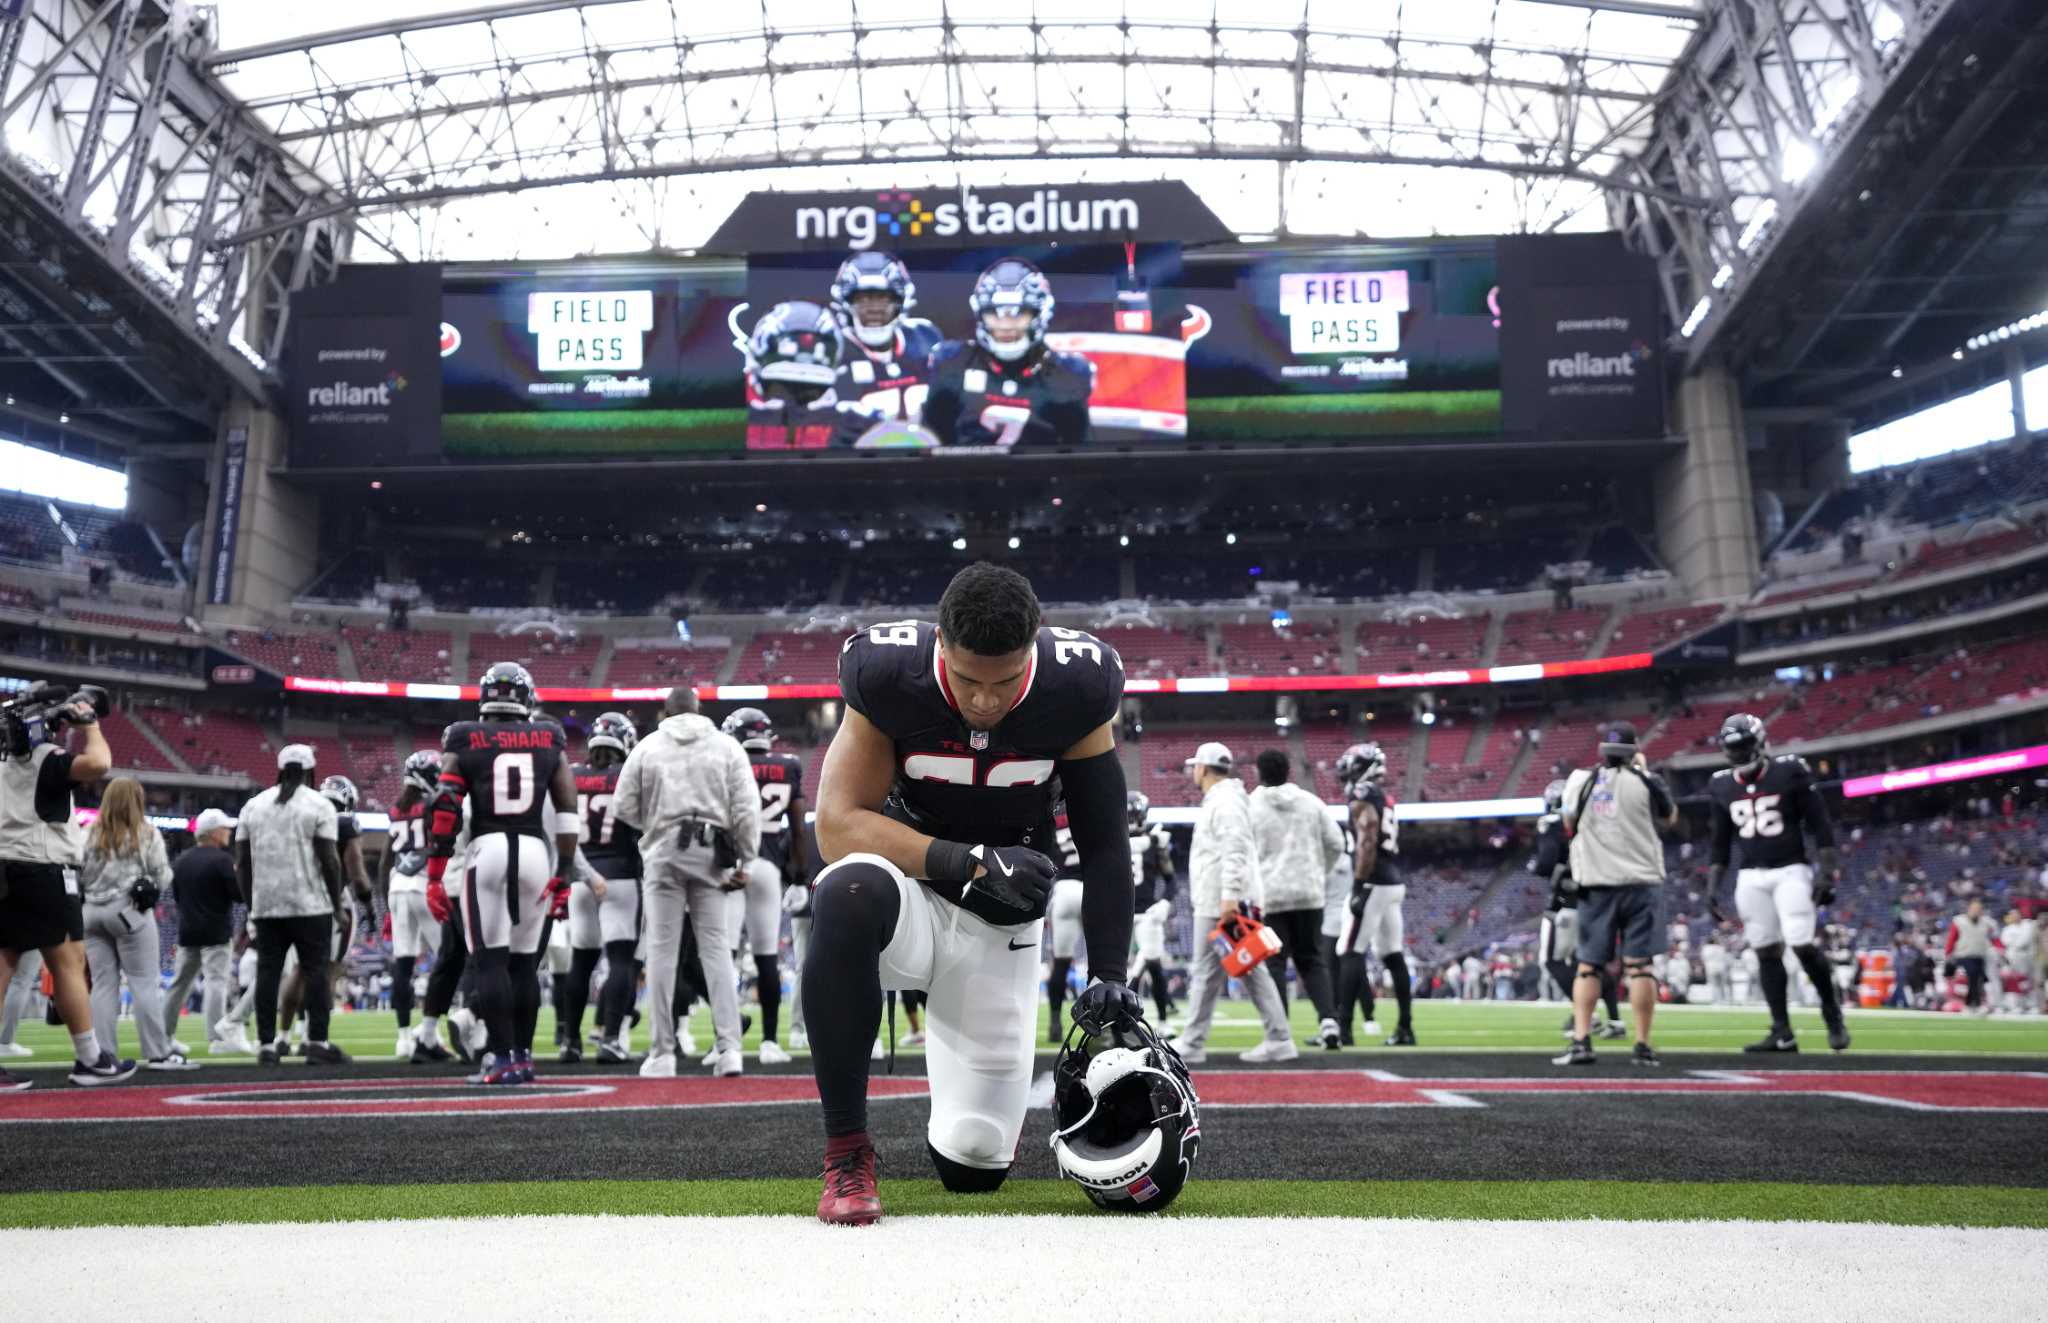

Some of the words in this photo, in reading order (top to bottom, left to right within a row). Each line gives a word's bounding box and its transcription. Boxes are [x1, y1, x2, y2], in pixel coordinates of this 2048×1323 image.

[796, 205, 876, 249] nrg
[934, 189, 1140, 236] stadium
[1305, 278, 1384, 305] FIELD
[553, 298, 627, 323] FIELD
[1311, 319, 1378, 343] PASS
[558, 337, 623, 362] PASS
[1547, 351, 1636, 378] reliant
[308, 381, 391, 406] reliant
[468, 730, 554, 751] AL-SHAAIR
[492, 751, 535, 816] 0
[757, 782, 792, 833] 2
[1728, 793, 1784, 839] 96
[1066, 1160, 1149, 1187] HOUSTON
